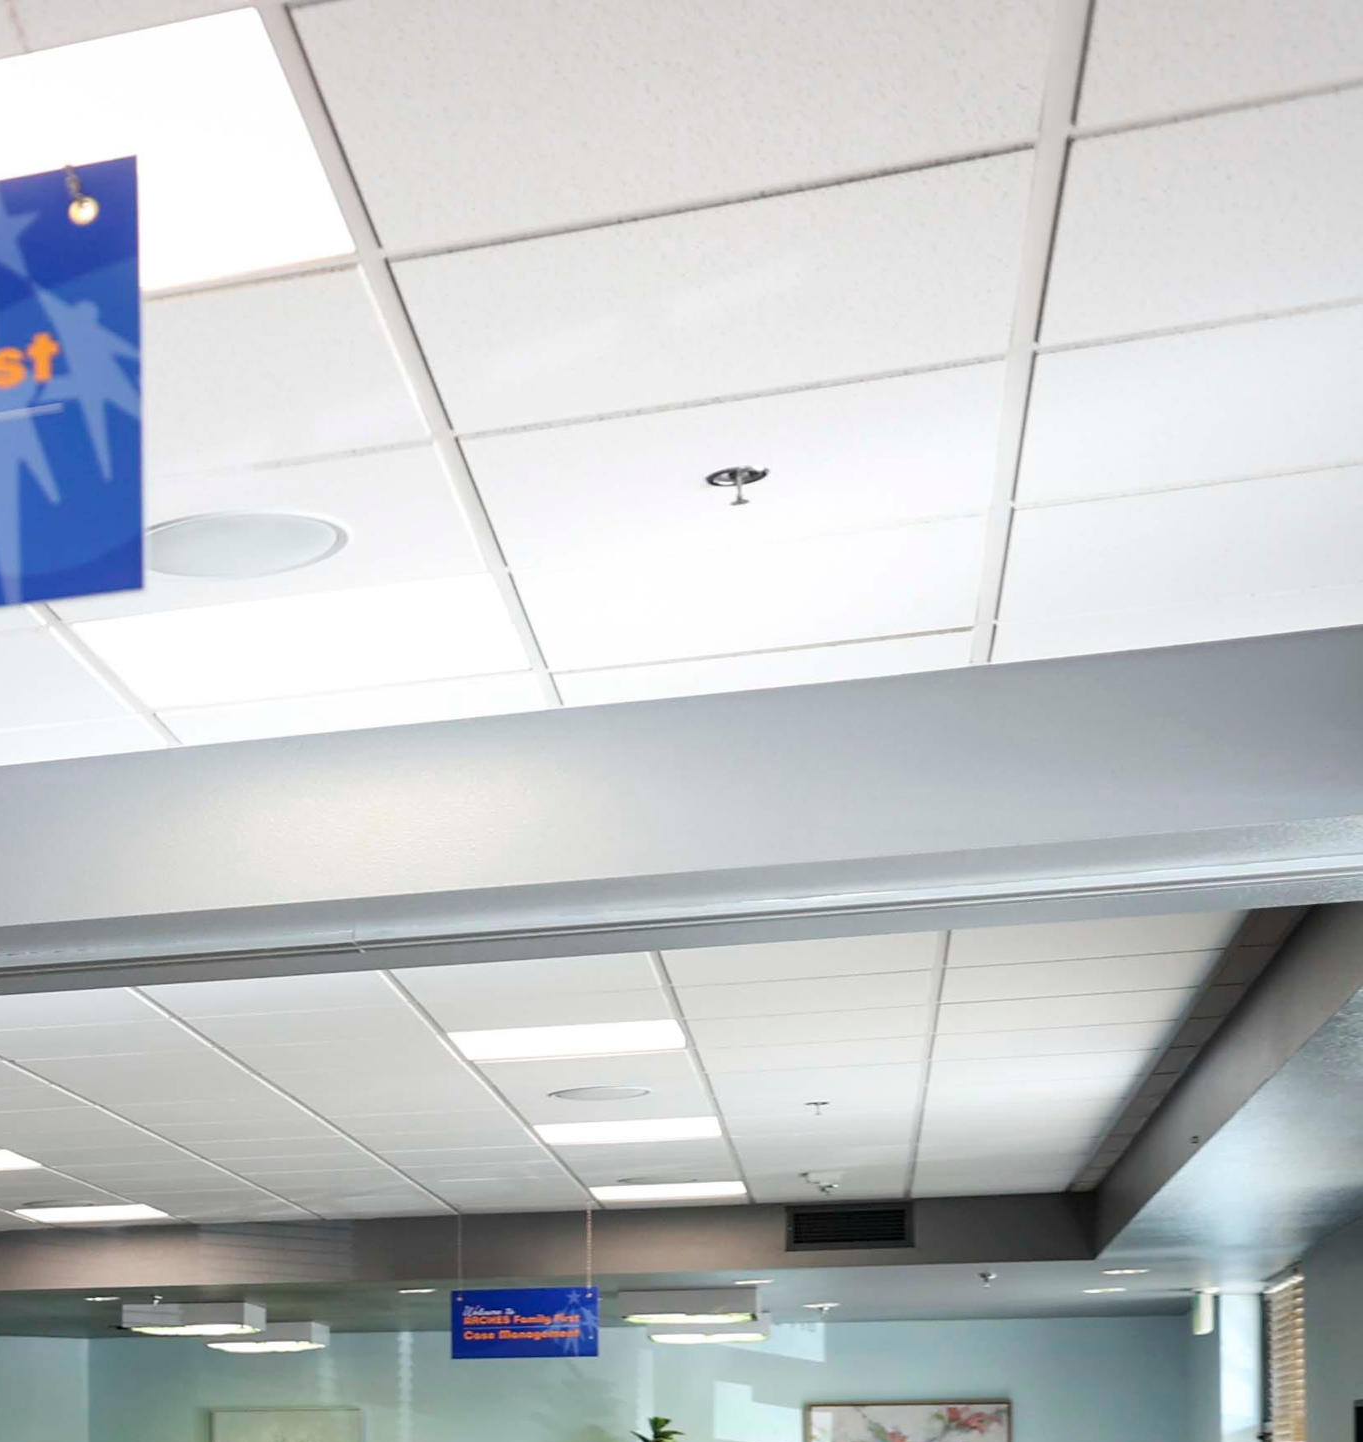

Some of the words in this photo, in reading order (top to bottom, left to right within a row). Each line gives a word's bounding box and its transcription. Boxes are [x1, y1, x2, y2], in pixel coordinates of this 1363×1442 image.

[462, 1305, 503, 1317] Welcome
[504, 1307, 515, 1316] to
[463, 1315, 511, 1325] ARCHES
[513, 1314, 552, 1325] Family
[553, 1312, 581, 1323] First
[463, 1330, 495, 1340] Case
[498, 1328, 581, 1341] Management
